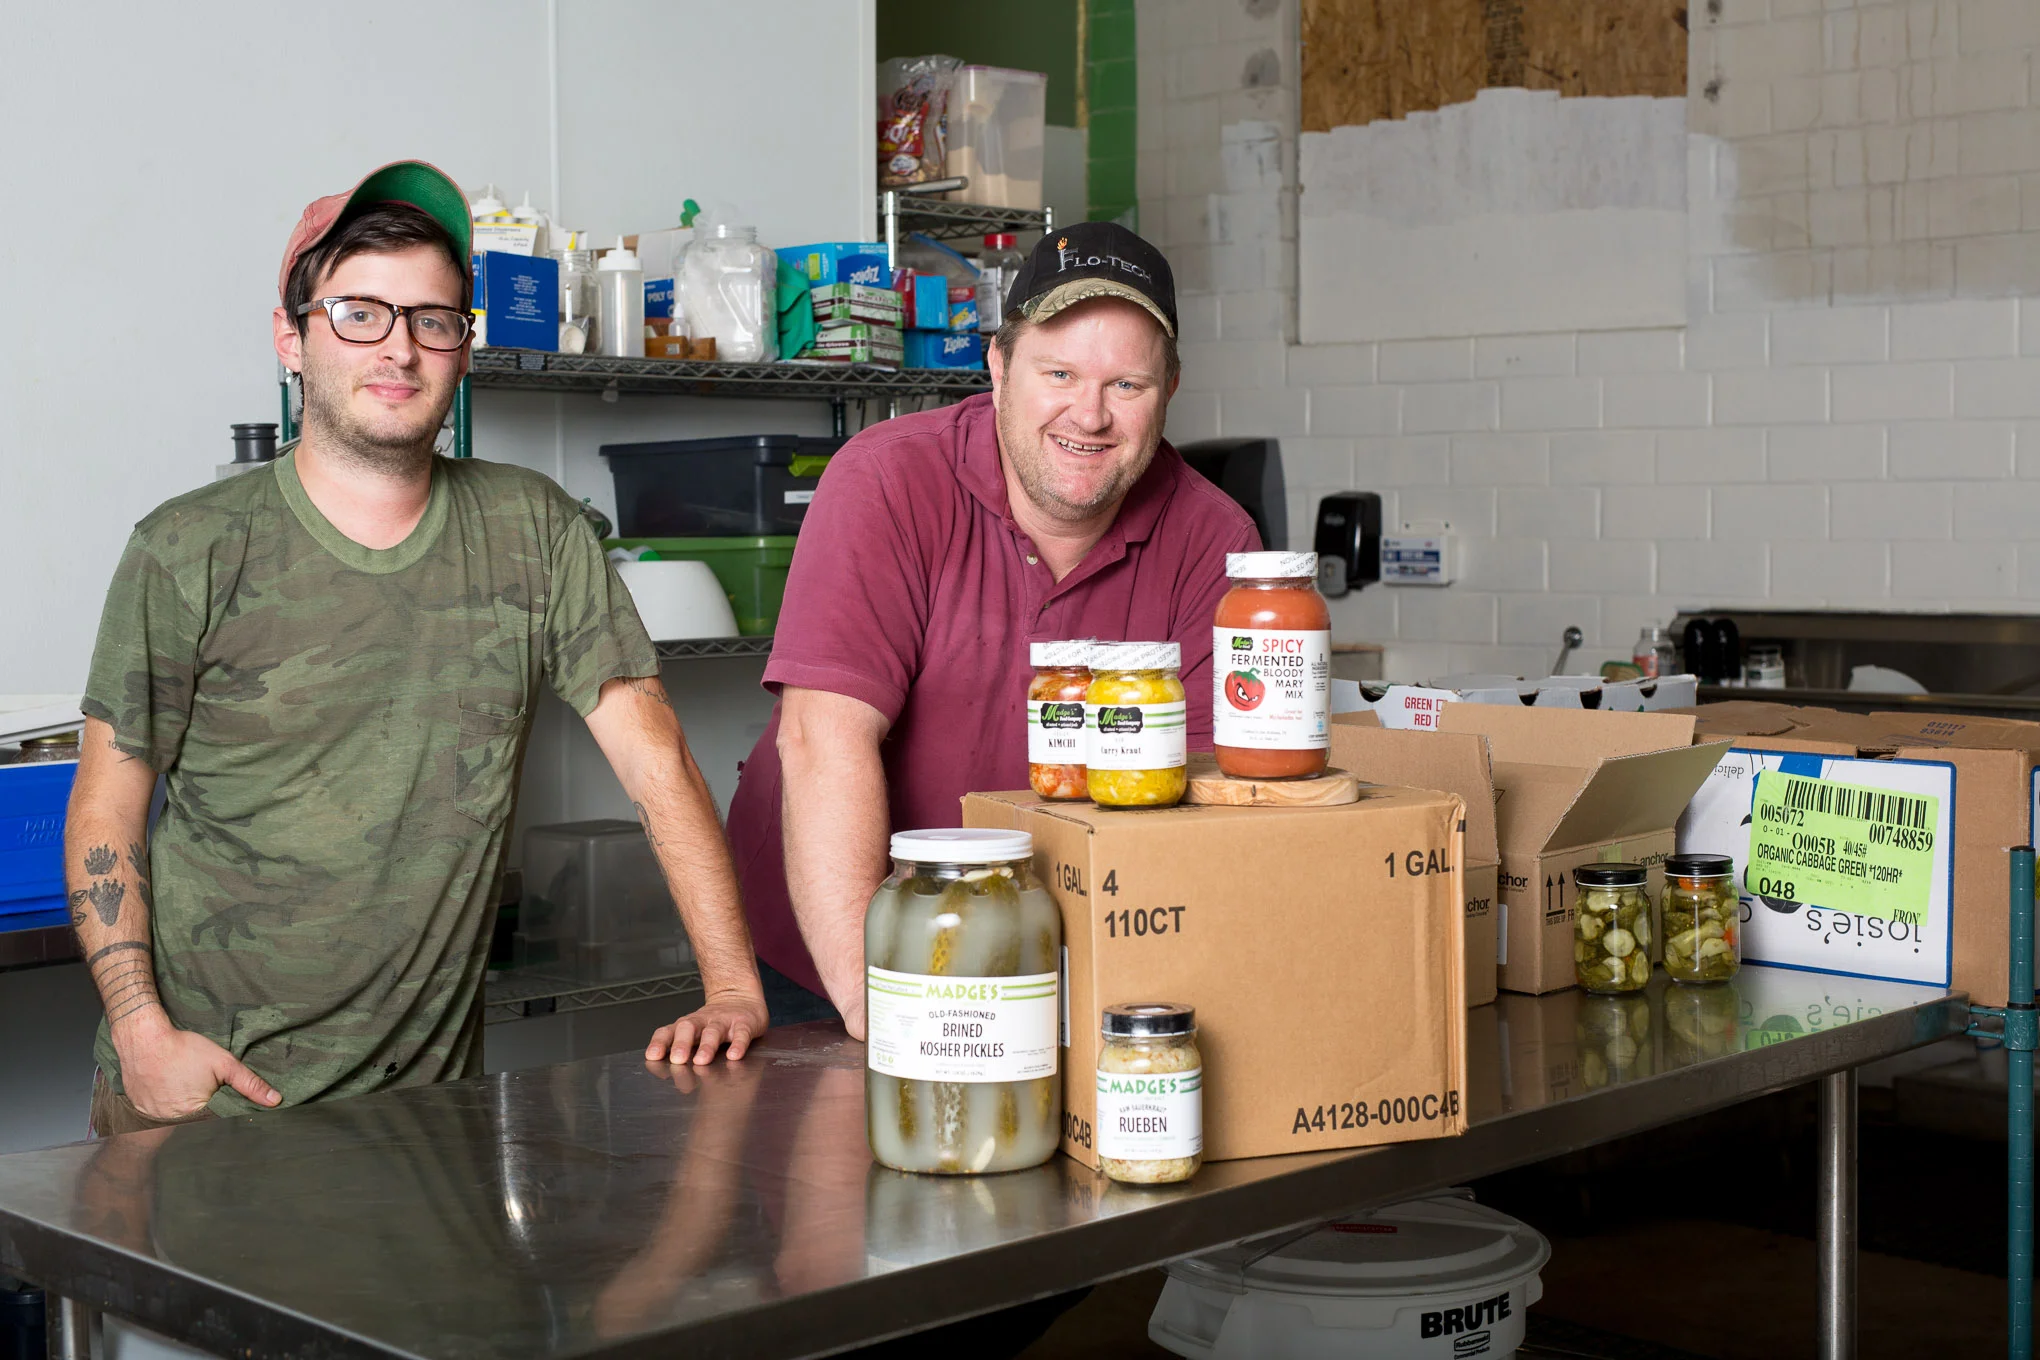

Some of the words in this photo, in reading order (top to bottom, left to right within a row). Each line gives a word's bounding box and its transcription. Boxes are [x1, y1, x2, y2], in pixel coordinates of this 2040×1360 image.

[850, 265, 880, 284] Ziploc
[943, 335, 971, 354] Ziploc
[1262, 638, 1304, 653] SPICY
[1231, 654, 1304, 667] FERMENTED
[1263, 669, 1304, 677] BLOODY
[1275, 679, 1304, 688] MARY
[1284, 690, 1304, 699] MIX
[1404, 696, 1433, 711] GREEN
[1414, 713, 1432, 727] RED
[1048, 738, 1076, 748] KIMCHI
[1101, 746, 1118, 757] Curry
[1121, 745, 1142, 755] Kraut
[1760, 803, 1804, 827] 005072
[1869, 823, 1933, 853] 00748859
[1384, 852, 1394, 878] 1
[1405, 848, 1455, 876] GAL.
[1757, 842, 1795, 864] ORGANIC
[1796, 851, 1837, 872] CABBAGE
[1838, 858, 1867, 878] GREEN
[1056, 861, 1061, 888] 1
[1063, 864, 1087, 897] GAL.
[1102, 869, 1119, 896] 4
[1759, 877, 1795, 900] 048
[1465, 897, 1490, 912] chor
[1104, 906, 1186, 938] 110CT
[926, 983, 998, 1000] MADGE'S
[928, 1009, 996, 1020] OLD-FASHIONED
[943, 1022, 983, 1038] BRINED
[920, 1041, 961, 1057] KOSHER
[963, 1043, 1004, 1058] PICKLES
[1110, 1078, 1177, 1095] MADGE'S
[1291, 1090, 1459, 1135] A4128-000C4B
[1119, 1116, 1167, 1133] RUEBEN
[1420, 1291, 1512, 1339] BRUTE
